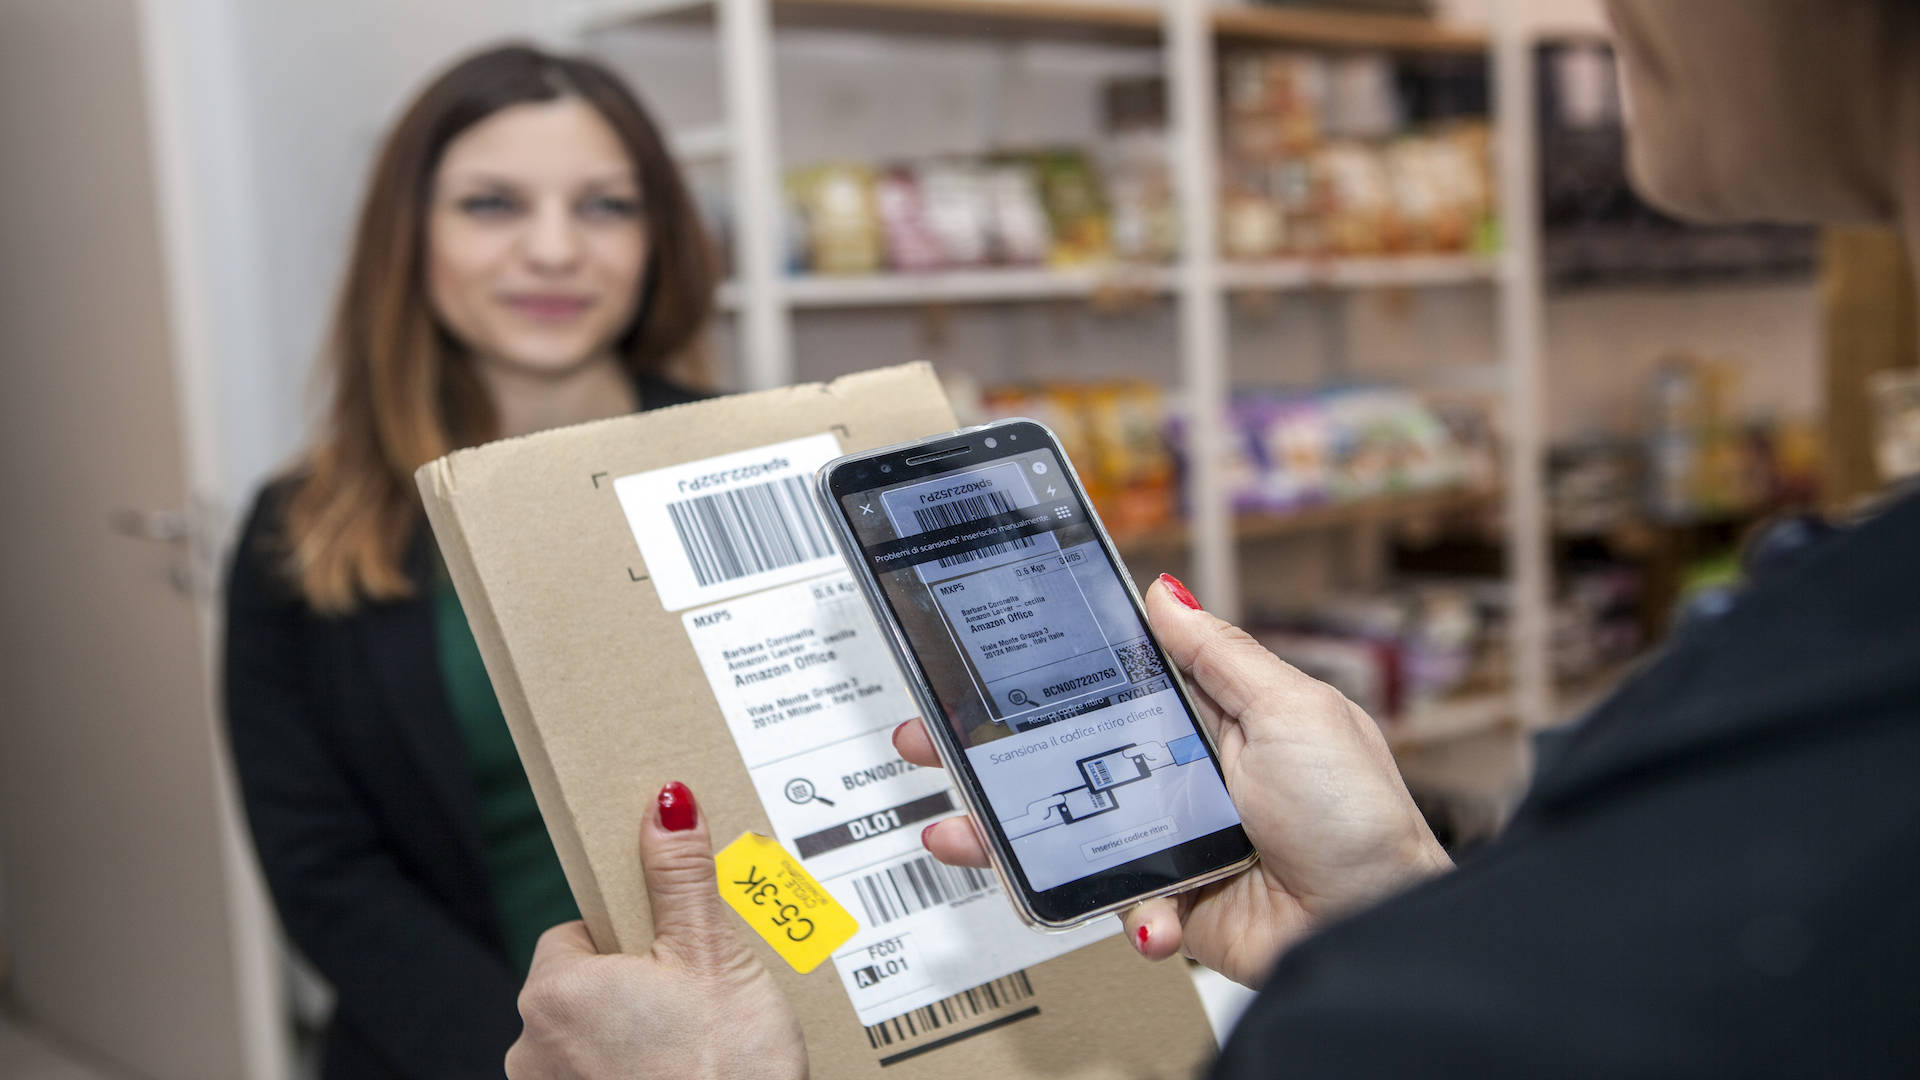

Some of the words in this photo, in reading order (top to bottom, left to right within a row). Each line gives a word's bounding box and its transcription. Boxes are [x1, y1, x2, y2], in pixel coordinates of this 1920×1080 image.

[875, 549, 911, 563] Problemi
[911, 546, 920, 555] di
[920, 535, 961, 552] scansione?
[939, 582, 965, 596] MXP5
[693, 610, 732, 629] MXP5
[961, 604, 988, 617] Barbara
[965, 613, 991, 624] Amazon
[970, 618, 1007, 634] Amazon
[1007, 610, 1034, 623] Office
[980, 642, 998, 653] Viale
[998, 636, 1019, 649] Monte
[1019, 630, 1044, 643] Grappa
[984, 648, 1005, 660] 20124
[1005, 642, 1028, 654] Milano
[728, 654, 769, 671] Amazon
[734, 663, 792, 688] Amazon
[794, 650, 838, 670] Office
[1042, 667, 1117, 698] BCN007220763
[1027, 711, 1057, 725] Ricerca
[1058, 702, 1084, 716] codice
[1085, 697, 1105, 708] ritiro
[990, 739, 1049, 765] Scansiona
[1060, 725, 1097, 744] codice
[1098, 717, 1125, 733] ritiro
[1127, 705, 1164, 725] cliente
[1091, 839, 1124, 855] Inserisci
[1124, 831, 1149, 844] codice
[1149, 824, 1169, 835] ritiro
[733, 865, 815, 942] C5-3K
